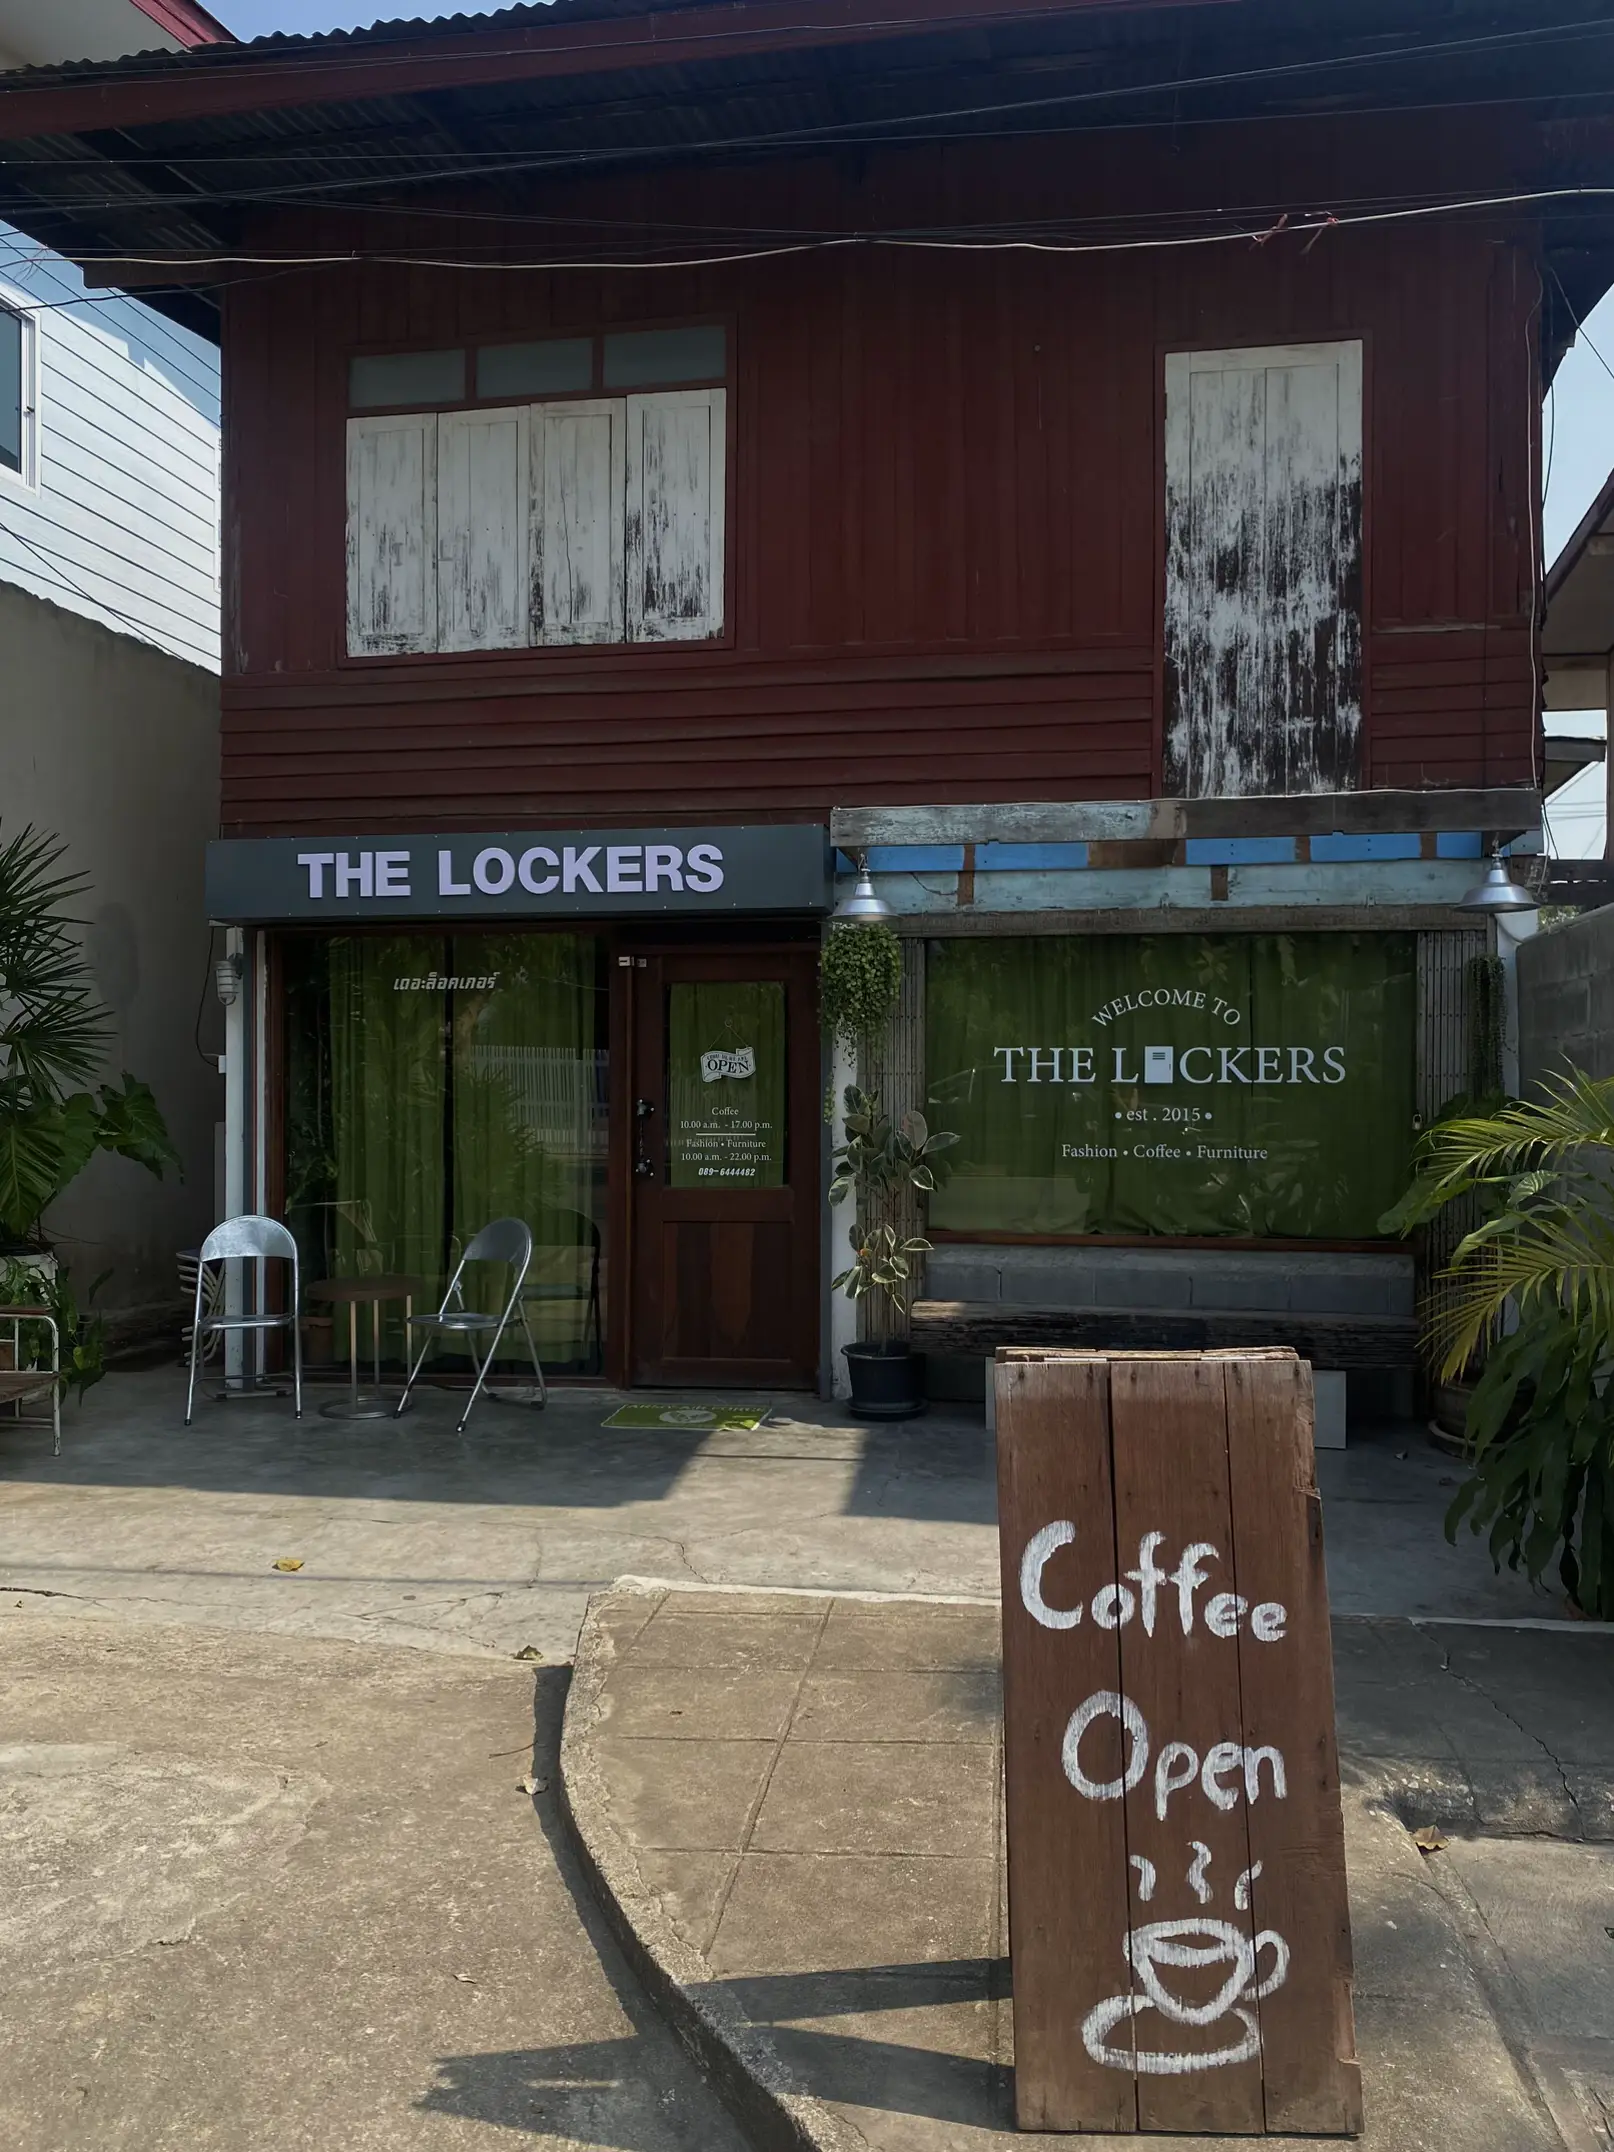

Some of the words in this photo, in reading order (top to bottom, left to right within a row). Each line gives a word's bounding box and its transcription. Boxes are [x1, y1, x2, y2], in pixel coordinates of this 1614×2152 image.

[297, 850, 411, 898] THE
[438, 844, 725, 895] LOCKERS
[1091, 988, 1206, 1028] WELCOME
[1211, 996, 1241, 1026] TO
[707, 1059, 750, 1074] OPEN
[994, 1046, 1097, 1083] THE
[711, 1106, 739, 1116] Coffee
[1162, 1107, 1201, 1122] 2015
[680, 1120, 702, 1129] 10.00
[731, 1120, 753, 1129] 17.00
[754, 1122, 773, 1132] p.m.
[686, 1138, 719, 1148] Fashion
[727, 1138, 766, 1148] Furniture
[681, 1152, 703, 1161] 10.00
[729, 1152, 752, 1161] 22.00
[753, 1154, 772, 1164] p.m.
[1062, 1143, 1118, 1158] Fashion
[1133, 1143, 1181, 1158] Coffee
[1197, 1144, 1268, 1160] Furniture
[698, 1167, 756, 1177] 089-6444482
[1019, 1519, 1288, 1642] Coffee
[1062, 1690, 1288, 1821] Open
